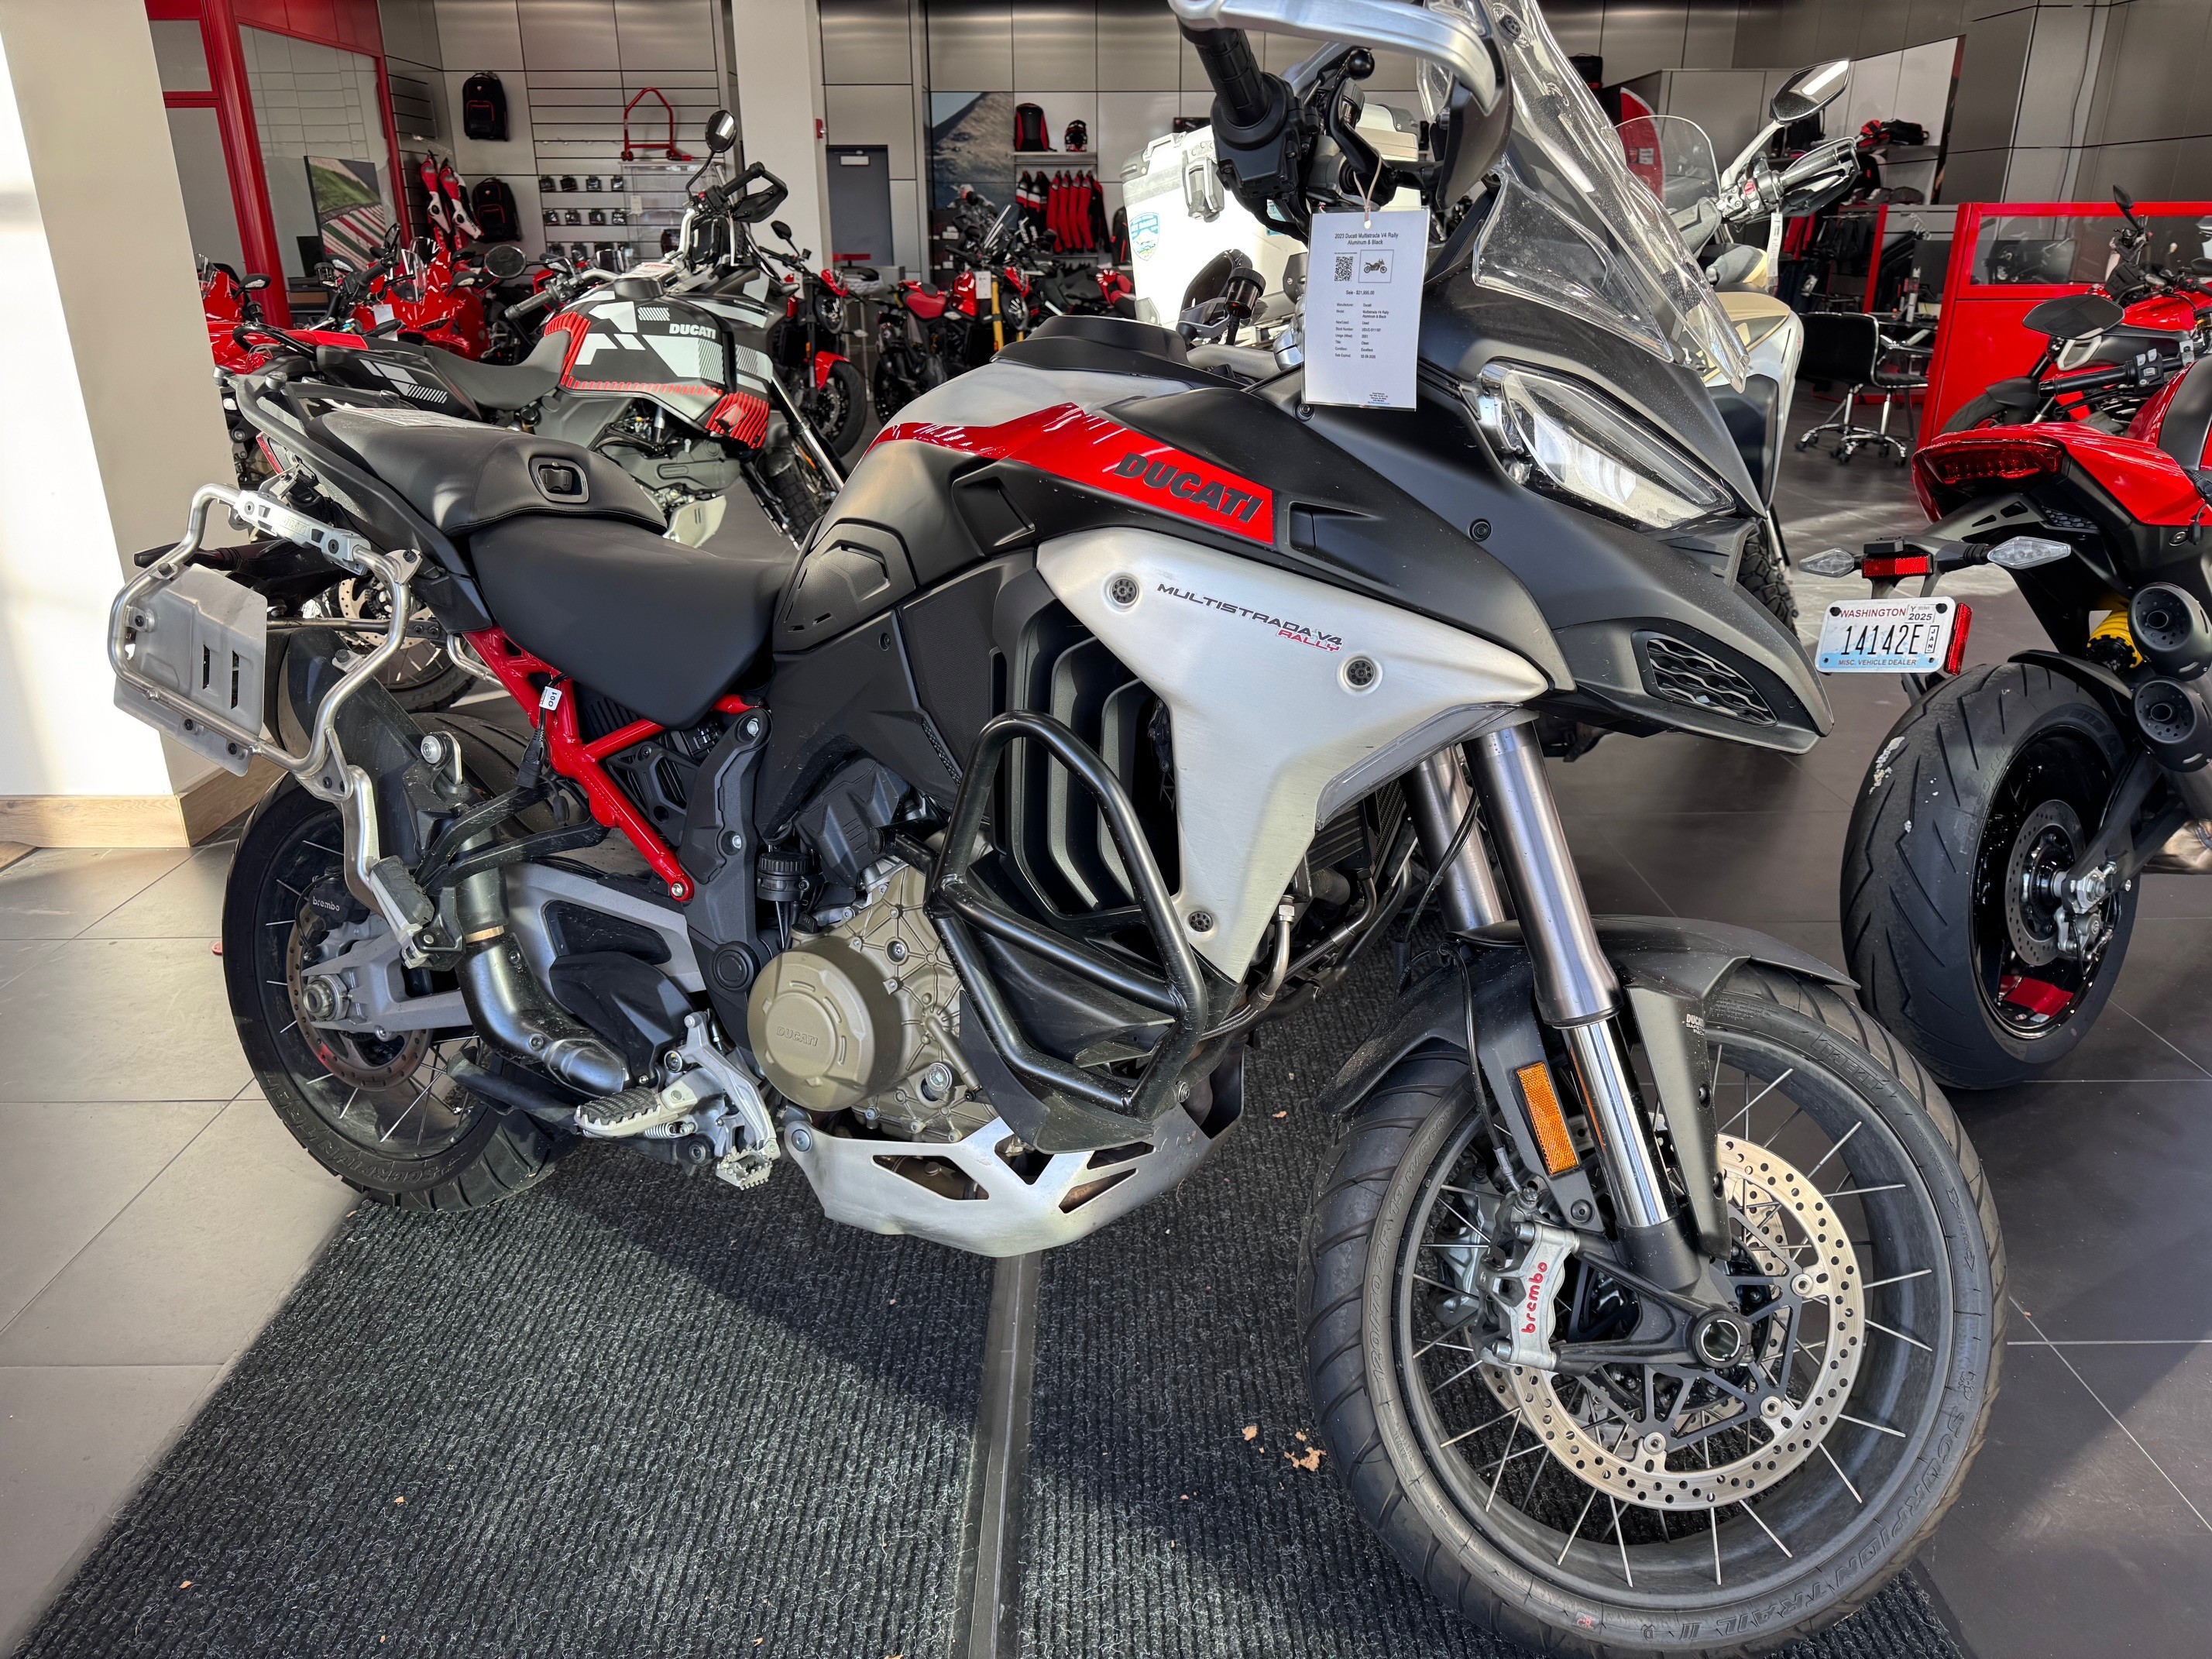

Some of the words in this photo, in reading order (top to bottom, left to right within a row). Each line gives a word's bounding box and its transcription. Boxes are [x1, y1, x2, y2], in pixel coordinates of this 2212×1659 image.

[668, 323, 717, 340] DUCATI
[1113, 452, 1264, 524] DUCATI
[1156, 583, 1312, 637] MULTISTRADA
[1317, 630, 1344, 647] V4
[1839, 607, 1908, 618] WASHINGTON
[1908, 613, 1933, 621] 2025
[1277, 629, 1341, 652] RALLY
[1840, 624, 1924, 655] 14142E
[1927, 629, 1936, 649] JAN
[312, 895, 340, 912] brembo
[776, 1025, 819, 1047] DUCATI
[1389, 1183, 1404, 1215] 19
[1520, 1262, 1548, 1334] brembo
[1835, 1406, 1966, 1589] SCORPION
[1716, 1580, 1829, 1636] TRAIL
